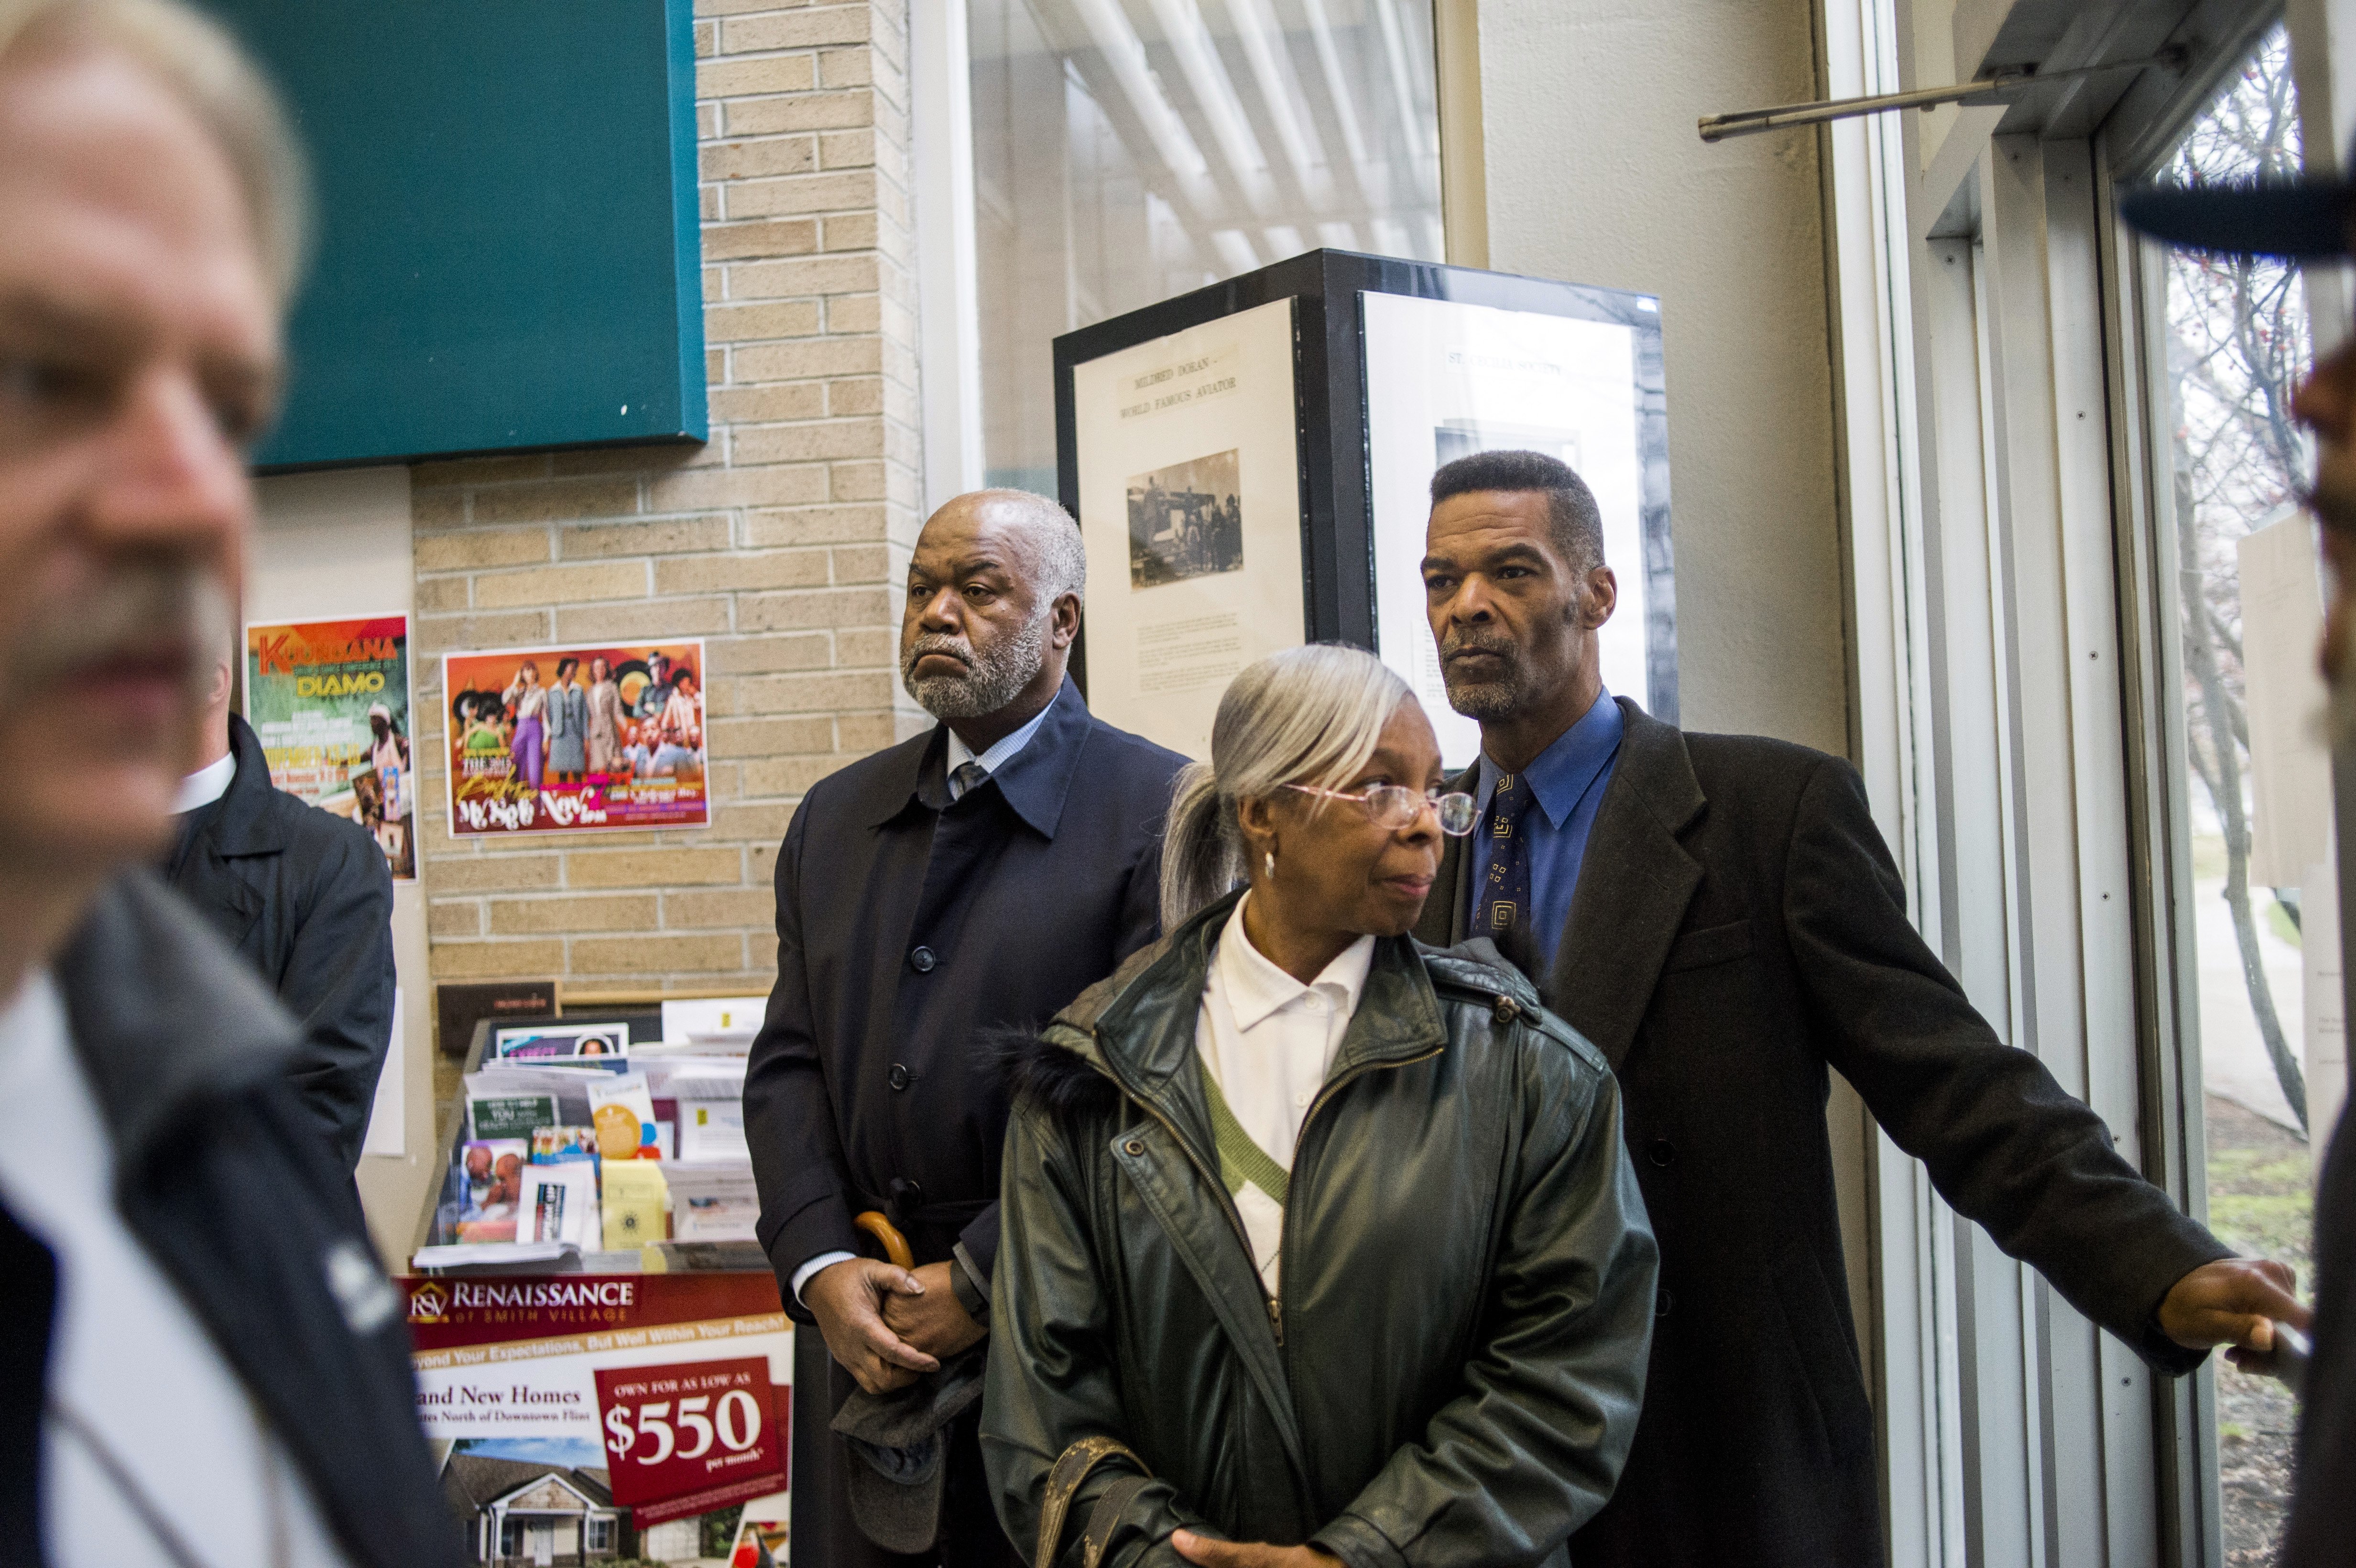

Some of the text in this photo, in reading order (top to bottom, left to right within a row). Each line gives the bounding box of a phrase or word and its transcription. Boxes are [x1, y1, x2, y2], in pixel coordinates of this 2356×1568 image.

[1134, 369, 1174, 390] MILDRED
[1178, 357, 1210, 377] DORAN
[1470, 355, 1514, 370] CECILIA
[1517, 359, 1562, 376] SOCIETY
[1120, 376, 1237, 419] WORLD FAMOUS AVIATOR
[296, 670, 386, 697] DIAMO
[453, 1282, 634, 1307] RENAISSANCE
[455, 1307, 627, 1324] OF SMITH VILLAGE
[414, 1317, 785, 1371] yond Your Expectations, But Well Within Your Reach!
[416, 1384, 581, 1405] and New Homes
[614, 1372, 751, 1398] OWN FOR AS LOW AS
[442, 1408, 476, 1423] North
[480, 1408, 492, 1422] of
[494, 1409, 559, 1423] Downtown
[563, 1408, 590, 1422] Flint
[605, 1390, 762, 1466] $550
[706, 1458, 723, 1473] per
